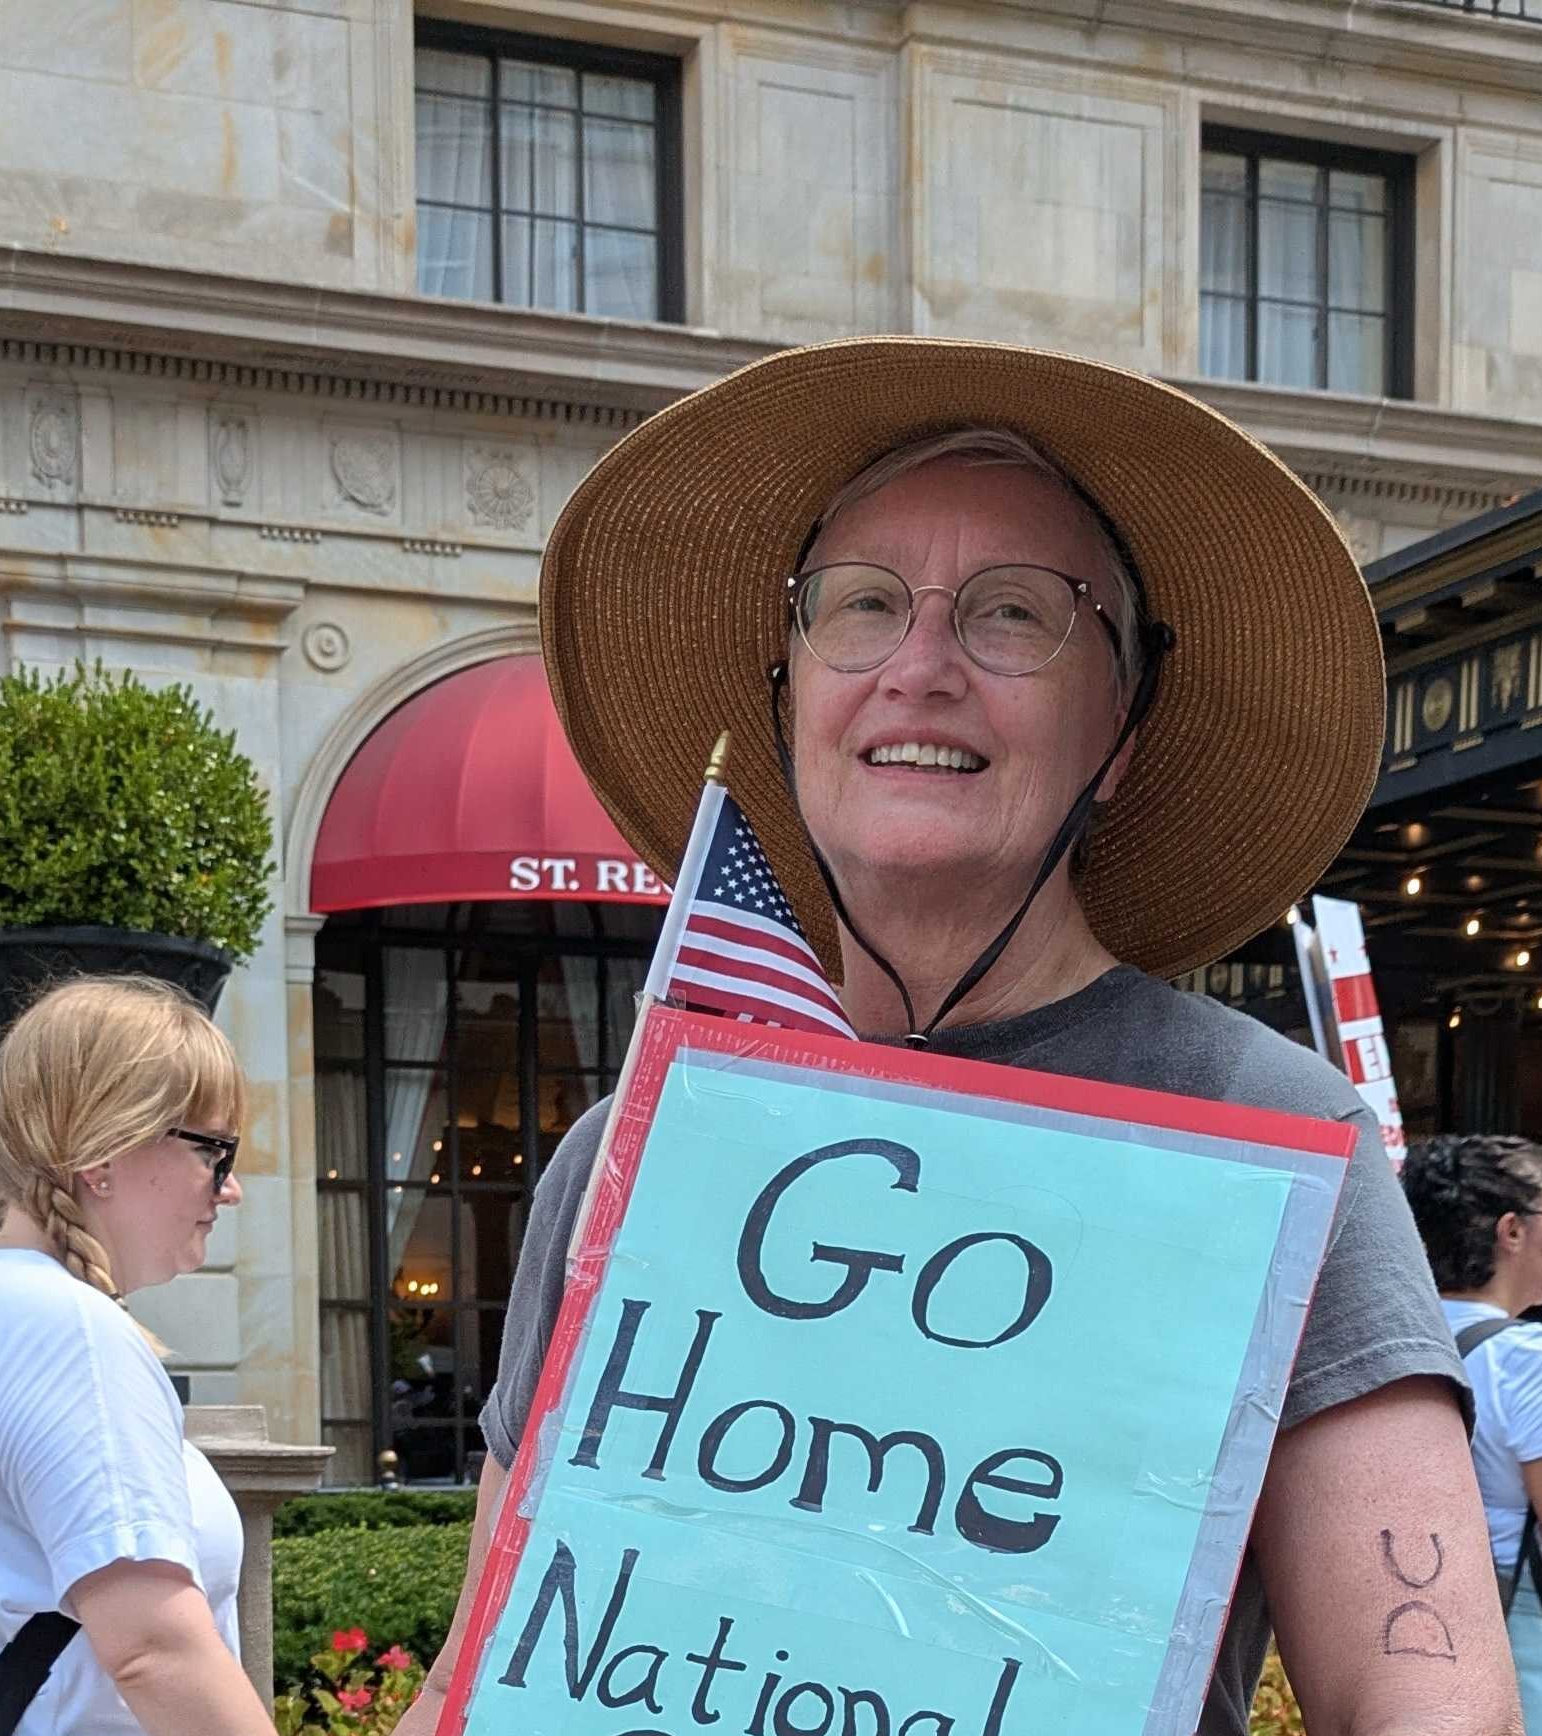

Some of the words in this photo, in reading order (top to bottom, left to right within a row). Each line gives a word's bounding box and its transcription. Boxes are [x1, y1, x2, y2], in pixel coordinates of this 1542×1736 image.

[510, 856, 580, 891] ST.
[596, 860, 672, 895] RE
[567, 1299, 1062, 1554] Home
[1380, 1528, 1456, 1662] DC
